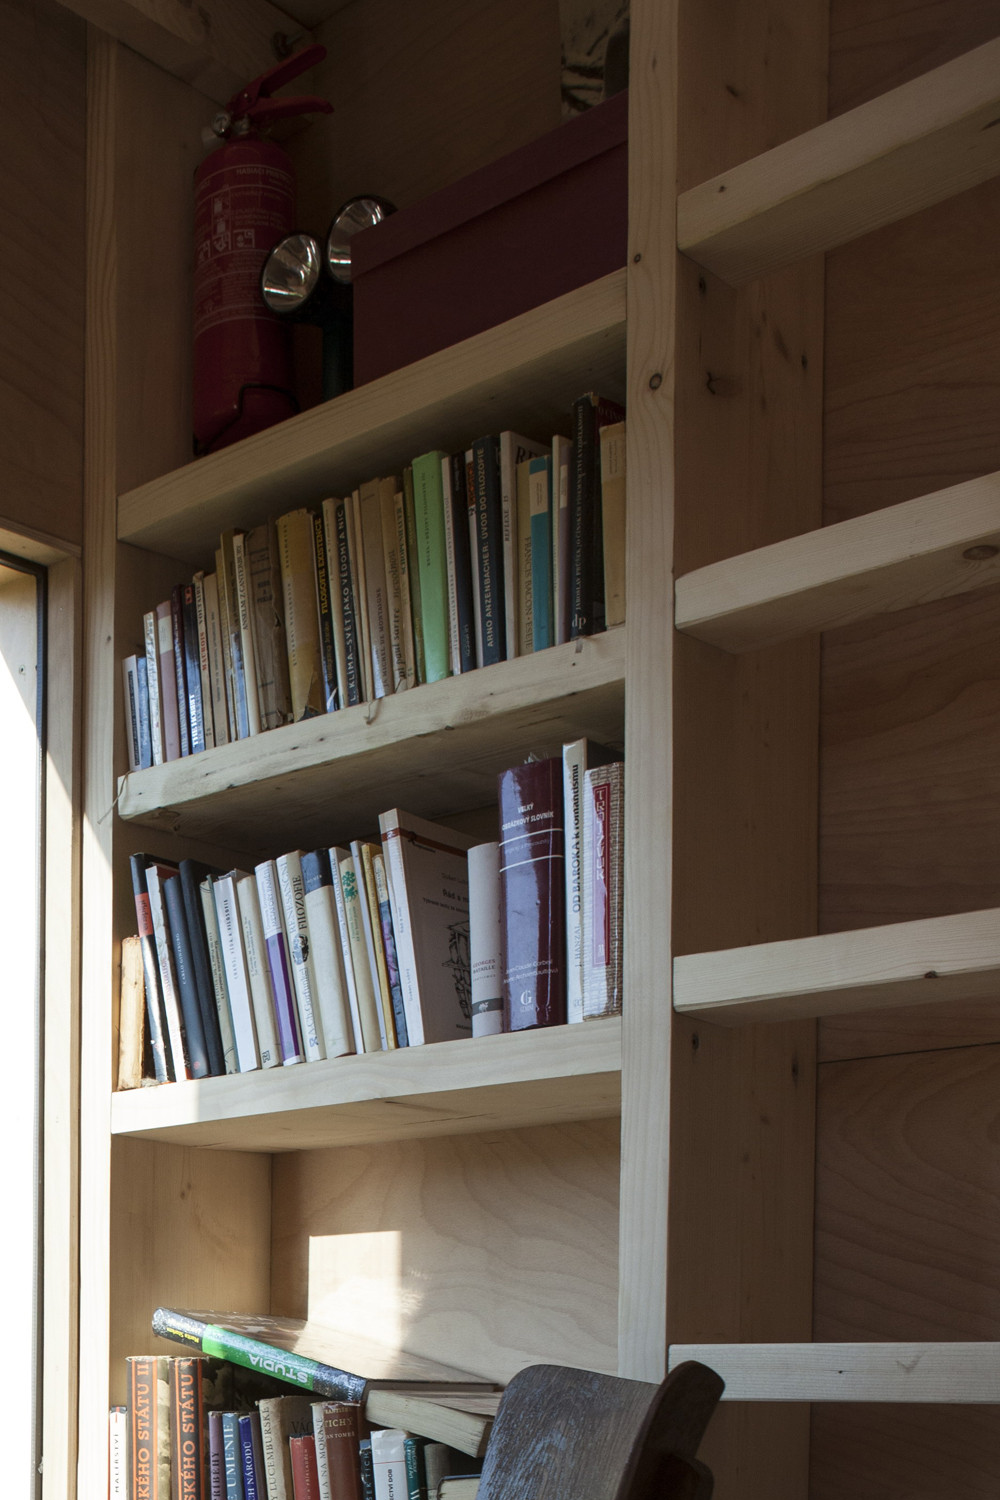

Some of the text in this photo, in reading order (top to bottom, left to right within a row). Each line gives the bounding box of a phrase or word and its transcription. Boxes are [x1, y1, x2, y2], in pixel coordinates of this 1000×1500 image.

[336, 509, 344, 527] NIC
[503, 509, 511, 542] REFLEXE
[314, 518, 325, 567] EXISTENCE
[395, 505, 406, 575] SCHOPENHAUER
[476, 448, 494, 647] ARNO ANZENBACHER: ÚVOD DO FILOZOFIE
[338, 542, 349, 584] VĚDOMÍ
[341, 586, 351, 615] JAKO
[375, 587, 385, 632] MONTAIGNE
[524, 537, 534, 649] FRANCIS BACON ESEJE
[574, 576, 583, 611] JAROSLAV
[195, 583, 208, 671] MAUROIS VOLTAIRE
[239, 599, 249, 630] ANSELM
[391, 607, 401, 640] sartre
[379, 646, 388, 677] MICHEL
[393, 642, 406, 665] paul
[350, 692, 357, 702] L.
[189, 693, 199, 748] THE HOBBIT
[517, 801, 535, 814] VELKÝ
[570, 764, 580, 833] romantismu
[530, 809, 555, 823] SLOVNÍK
[571, 842, 580, 892] BAROKA
[291, 875, 307, 930] FILOZOFIE
[571, 894, 580, 913] OD
[175, 933, 184, 964] GINZBURG
[472, 958, 496, 968] GEORGES
[178, 964, 186, 985] CARLO
[472, 964, 496, 974] BATAILLE
[249, 1352, 308, 1384] STUDIA
[135, 1384, 151, 1441] STÁTU
[179, 1374, 196, 1434] STÁTU
[222, 1422, 237, 1488] UMENIE
[262, 1407, 278, 1491] LUCEMBURSKÉ
[315, 1417, 327, 1460] MORAVĚ
[242, 1441, 255, 1485] NÁRODŮ
[320, 1463, 328, 1479] NA
[386, 1469, 394, 1483] DOB
[321, 1483, 329, 1491] A
